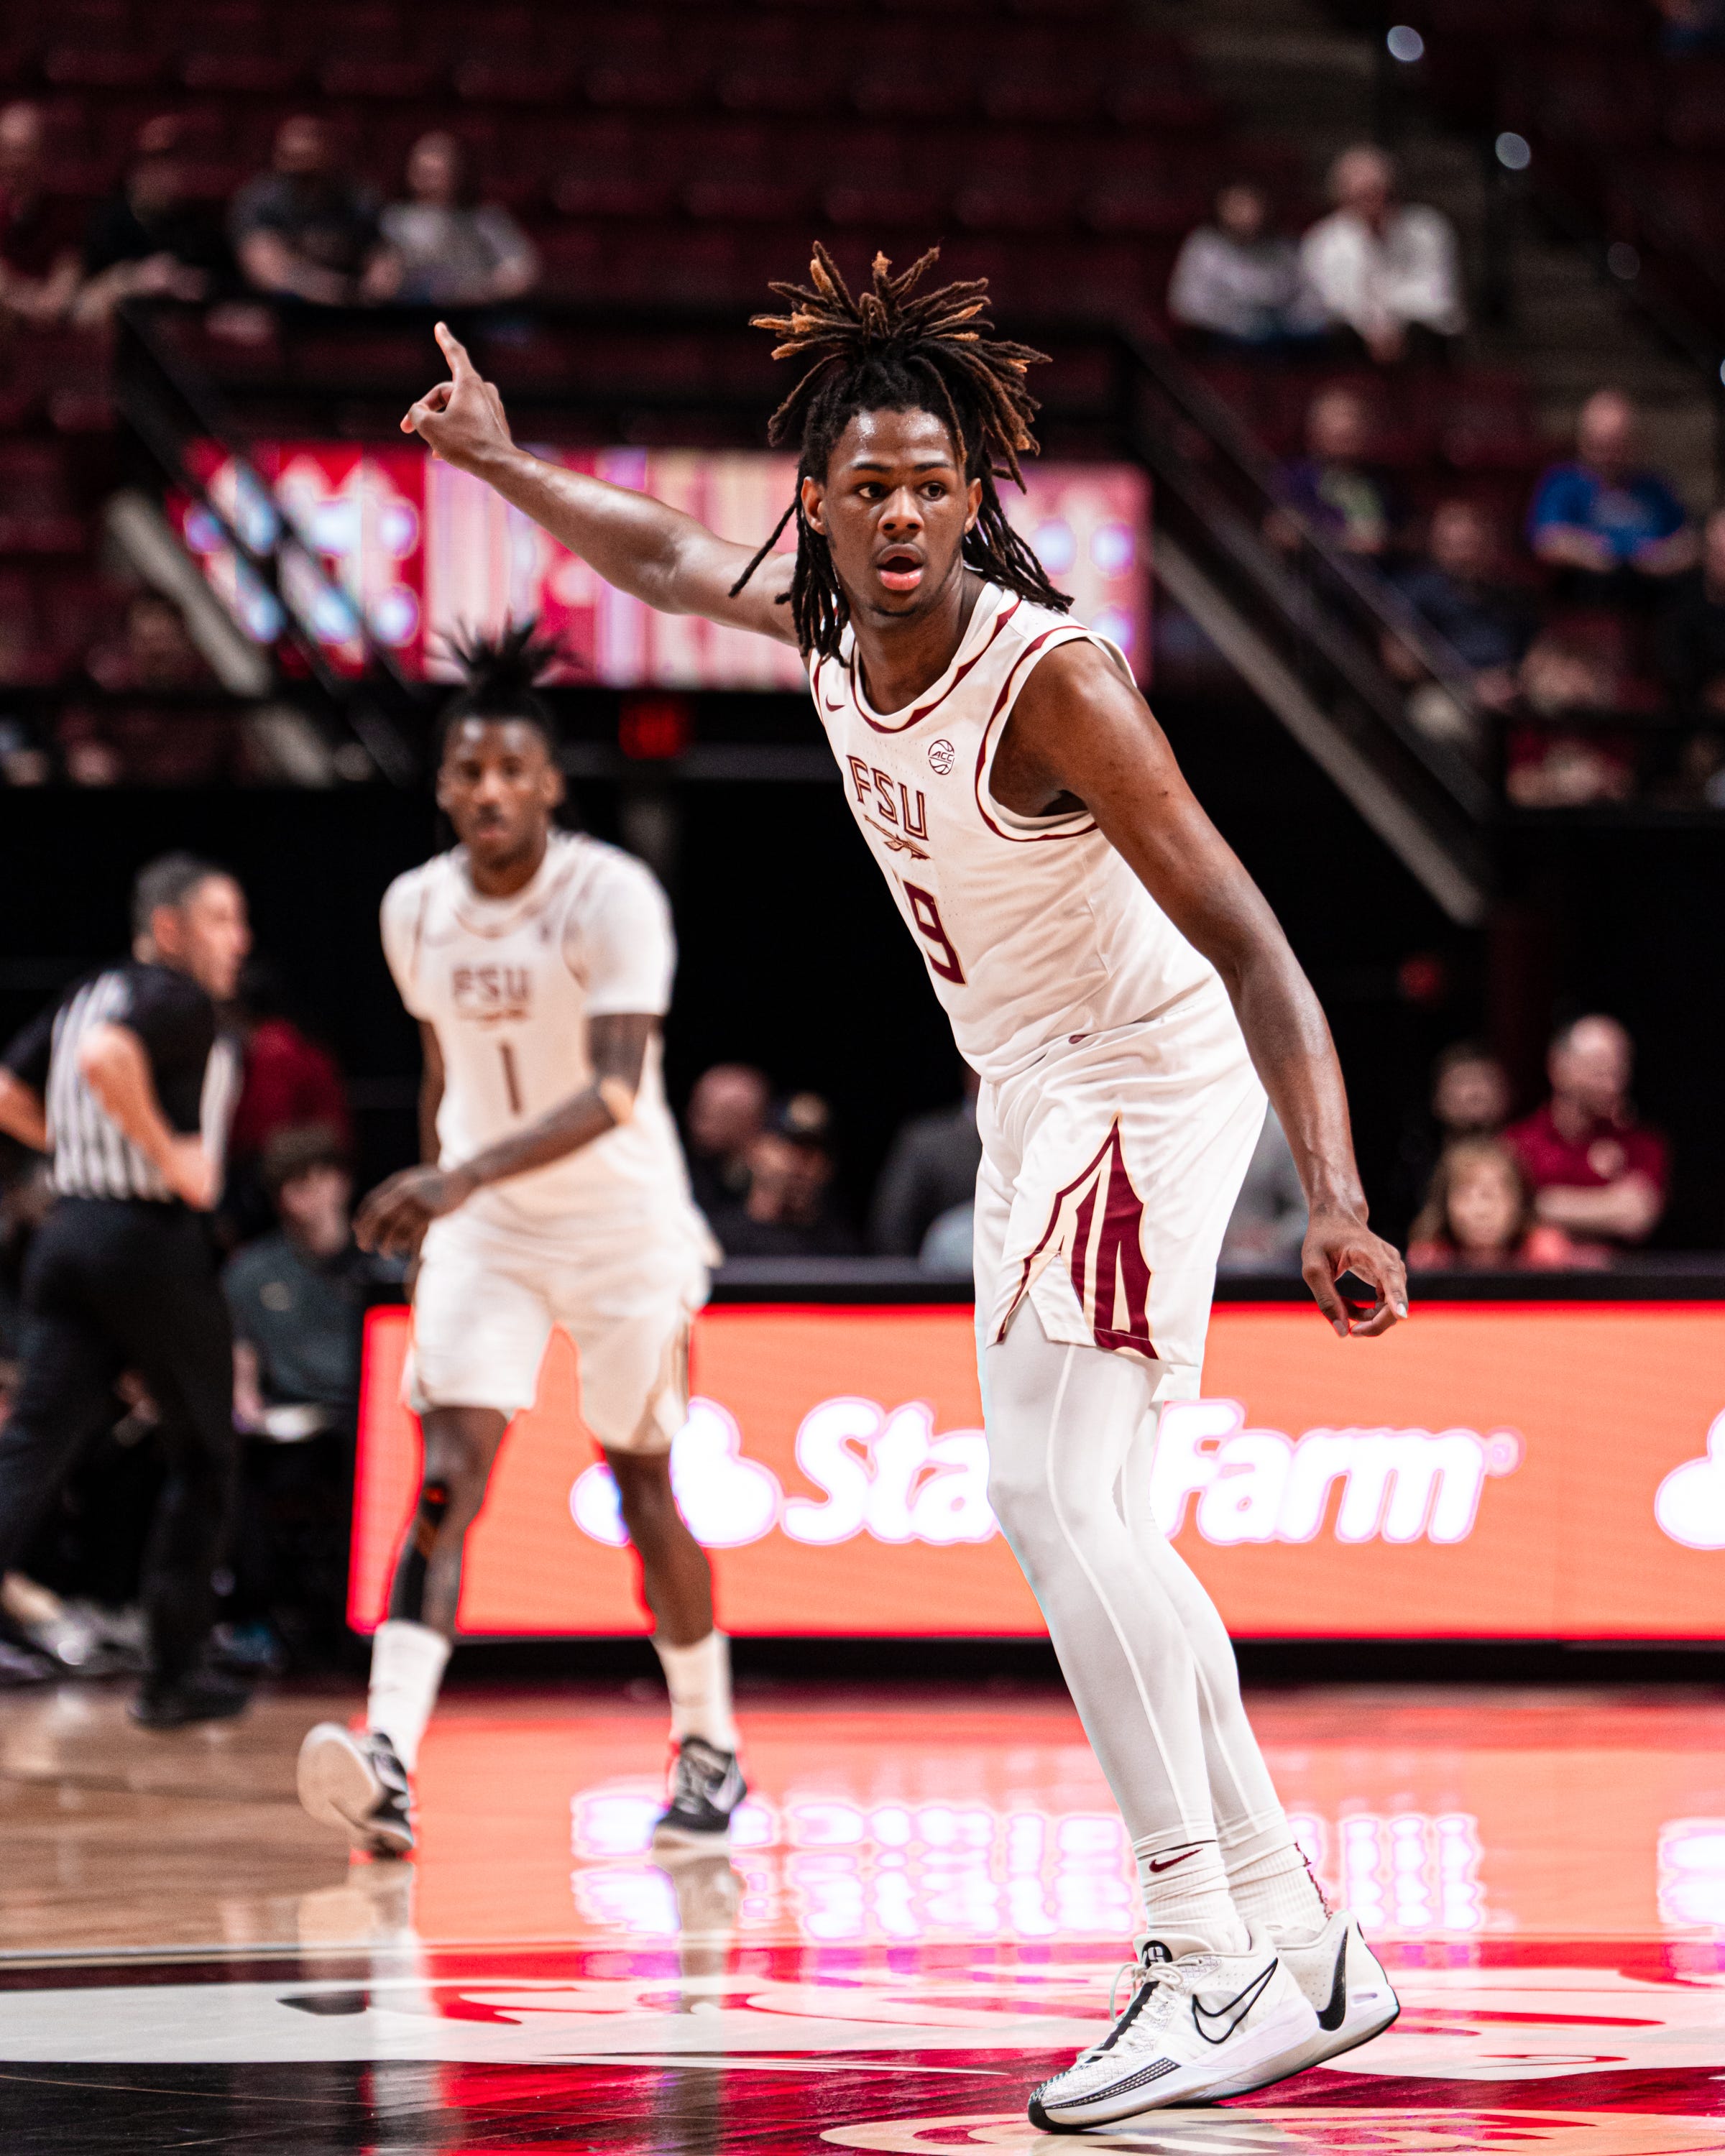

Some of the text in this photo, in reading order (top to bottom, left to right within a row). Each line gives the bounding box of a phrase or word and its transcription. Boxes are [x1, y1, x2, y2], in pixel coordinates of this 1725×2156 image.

[932, 751, 954, 763] ACC
[846, 755, 929, 841] FSU
[892, 868, 967, 986] 9
[451, 967, 531, 1003] FSU
[499, 1039, 523, 1116] 1
[781, 1396, 1488, 1545] Sta Farm
